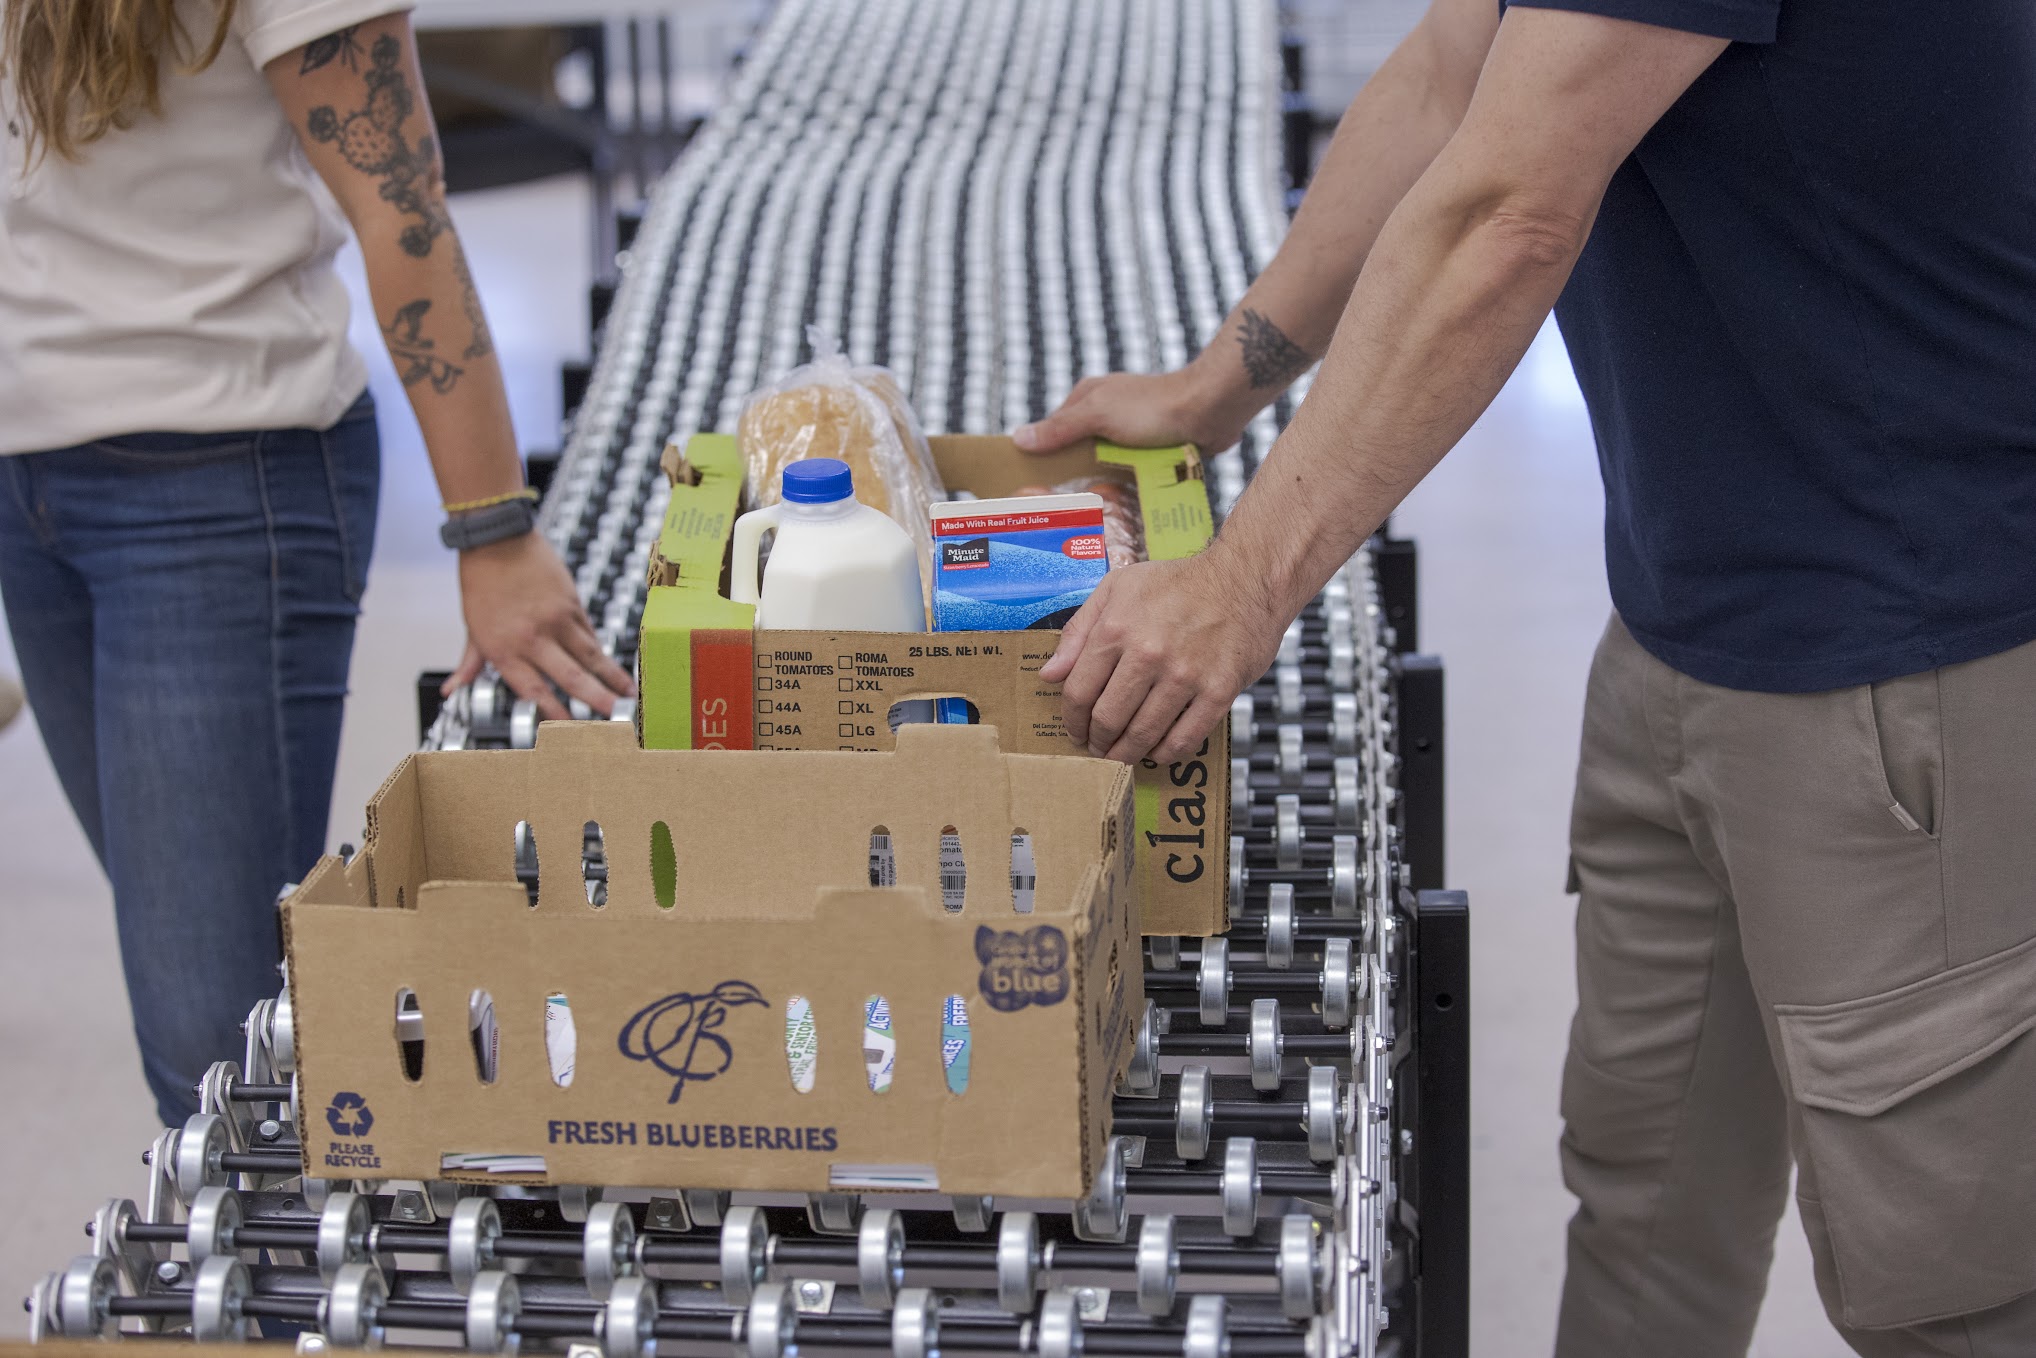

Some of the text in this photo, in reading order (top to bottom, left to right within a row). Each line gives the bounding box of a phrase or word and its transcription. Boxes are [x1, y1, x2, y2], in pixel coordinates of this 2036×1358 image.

[942, 516, 1049, 530] Made With Real Fruit Juice
[948, 547, 984, 556] Minute
[952, 554, 980, 562] Maid
[774, 651, 812, 662] ROUND
[909, 646, 923, 657] 25
[926, 646, 952, 657] LBS.
[856, 652, 888, 664] ROMA
[774, 664, 834, 676] TOMATOES
[856, 666, 914, 678] TOMATOES
[775, 679, 802, 690] 34A
[856, 680, 883, 691] XXL
[775, 702, 802, 712] 44A
[856, 703, 874, 714] XL
[776, 724, 802, 735] 45A
[856, 726, 875, 736] LG
[993, 968, 1060, 993] blue
[548, 1120, 838, 1151] FRESH BLUEBERRIES
[330, 1142, 374, 1155] PLEASE
[325, 1155, 382, 1168] RECYCLE
